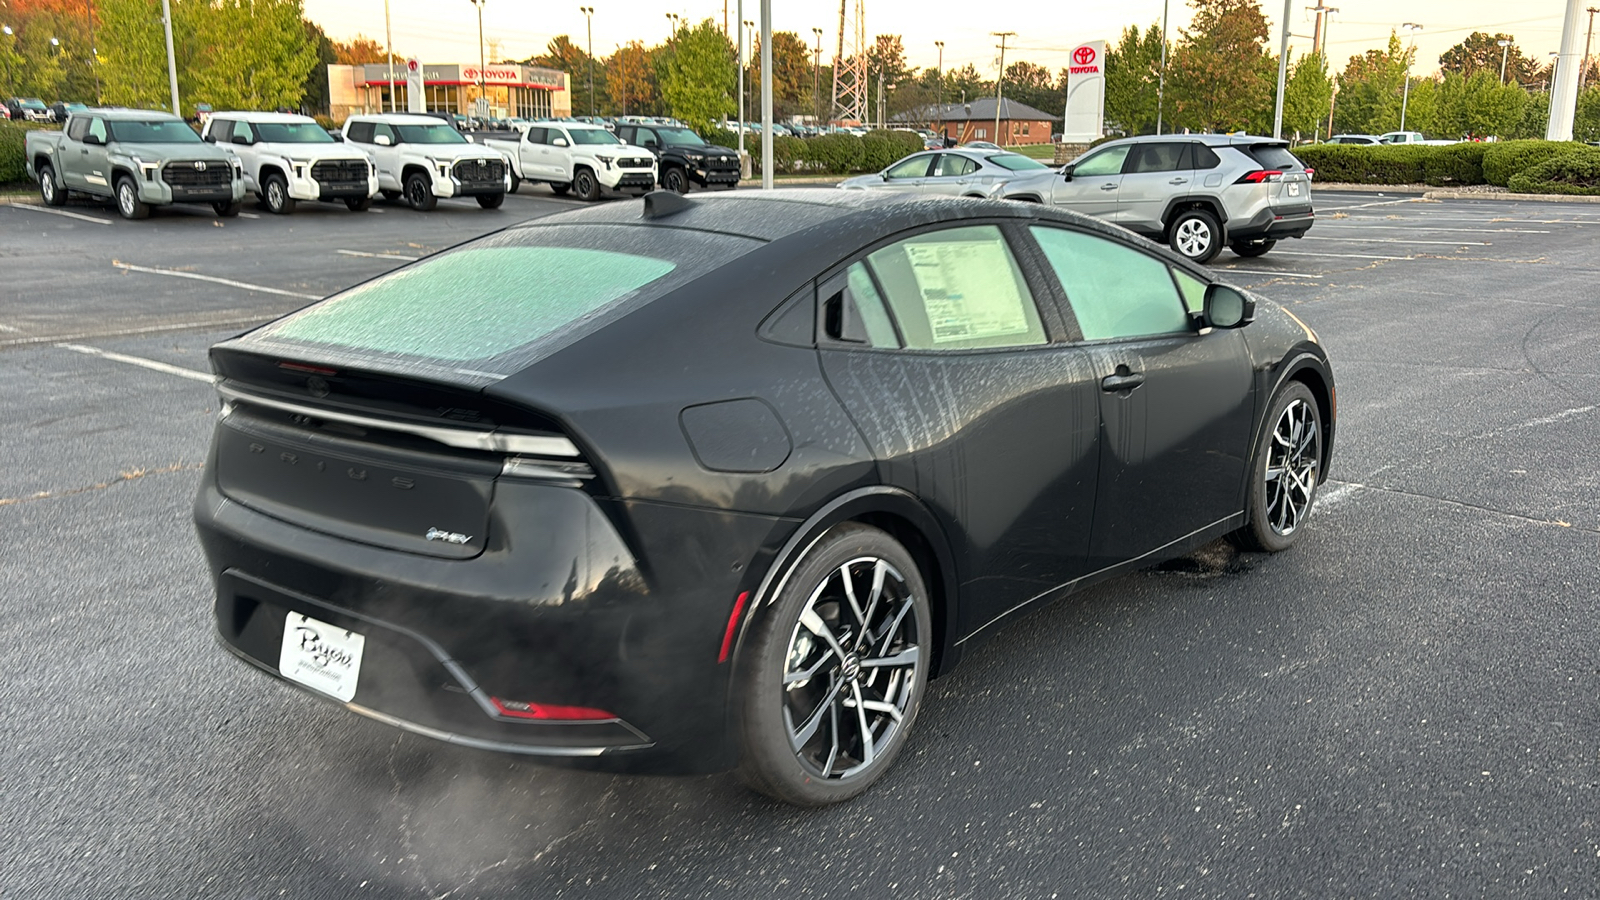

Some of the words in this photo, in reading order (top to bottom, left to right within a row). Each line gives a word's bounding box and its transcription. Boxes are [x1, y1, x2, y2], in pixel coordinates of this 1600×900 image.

[480, 69, 517, 80] TOYOTA
[1069, 65, 1099, 74] TOYOTA
[249, 442, 415, 490] PRIUS
